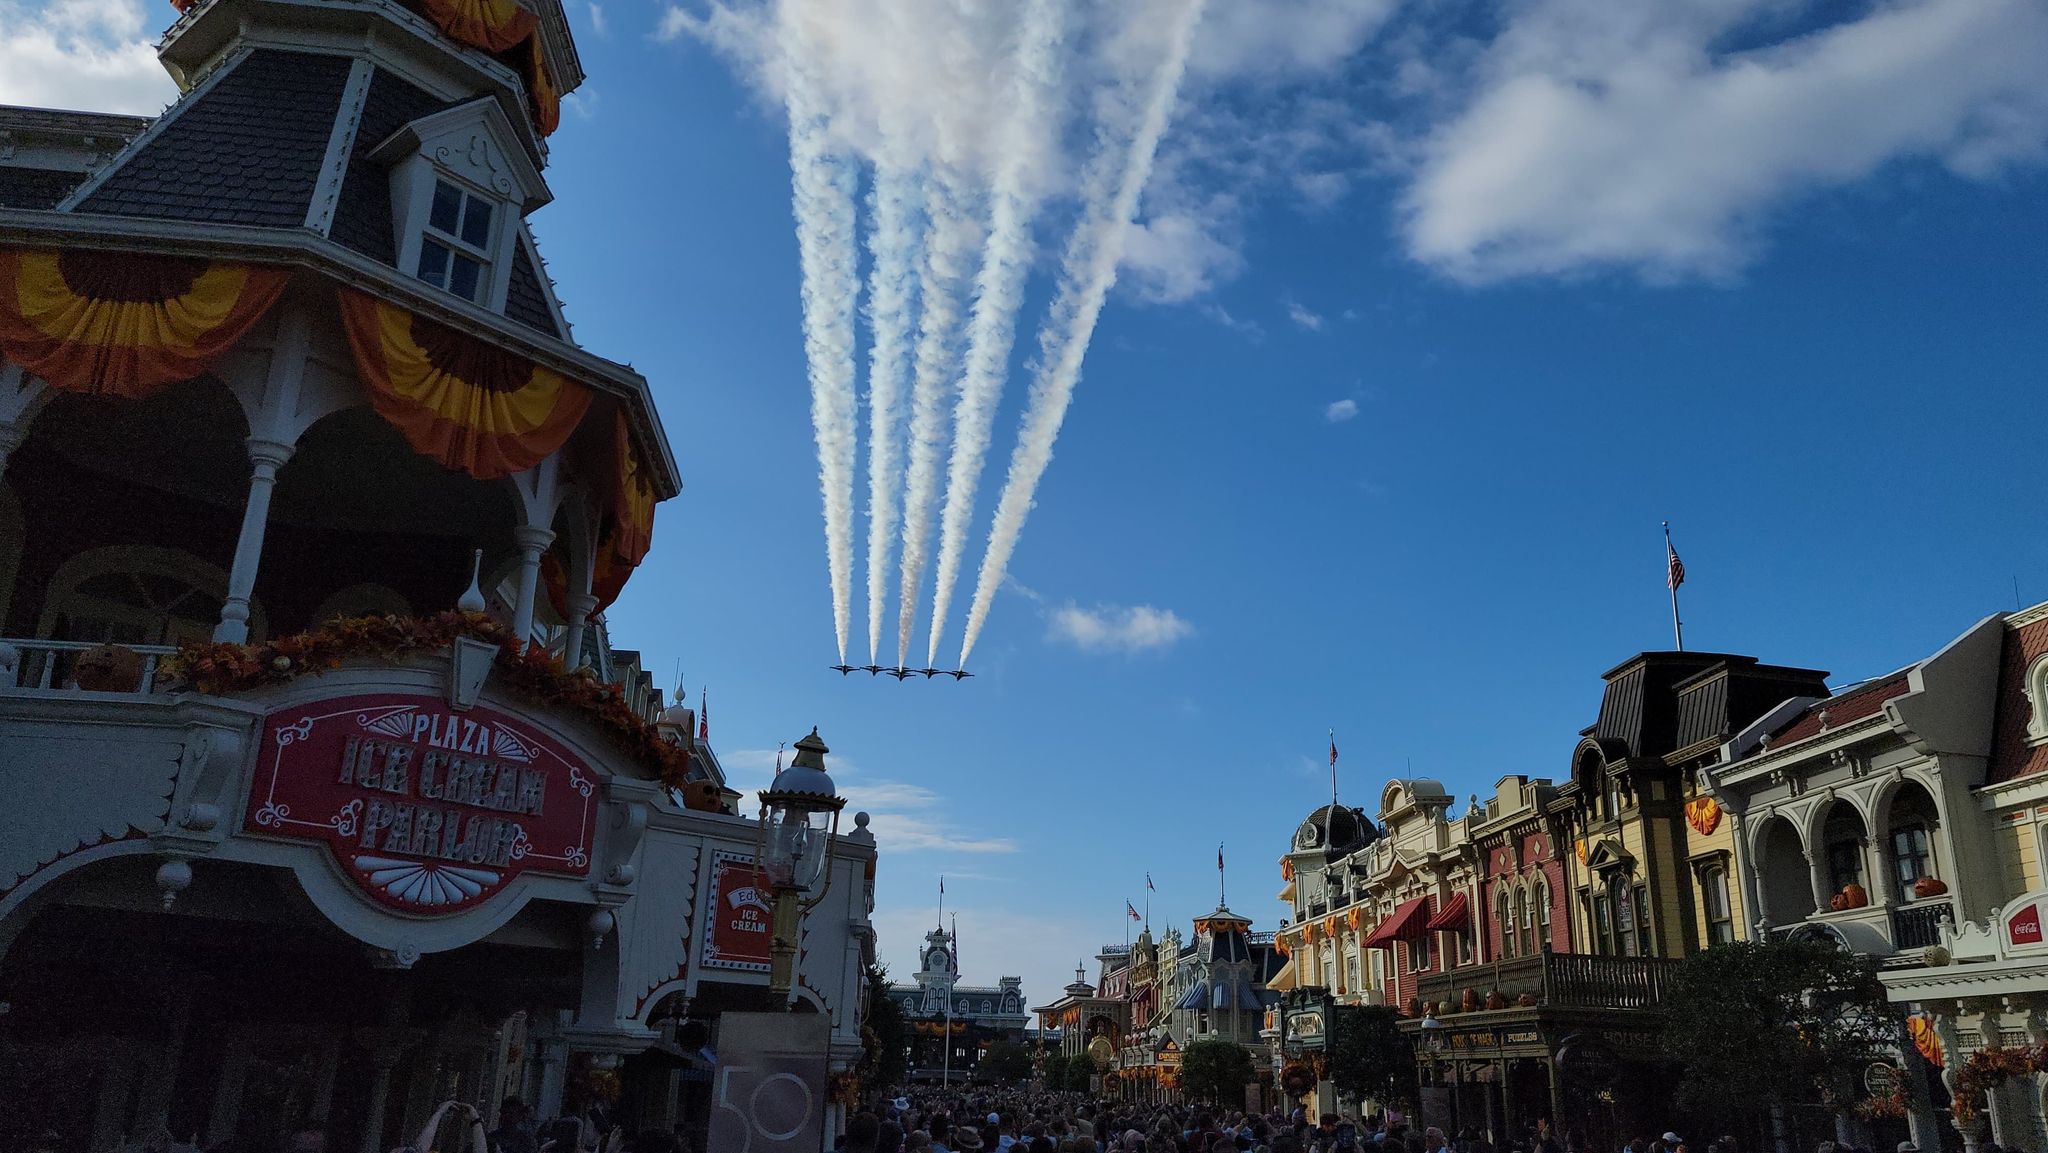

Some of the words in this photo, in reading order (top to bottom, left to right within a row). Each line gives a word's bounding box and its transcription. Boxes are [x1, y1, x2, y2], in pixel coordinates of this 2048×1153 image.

[411, 713, 490, 756] PLAZA
[338, 735, 416, 795] ICE
[420, 749, 549, 817] CREAM
[359, 797, 516, 868] PARLOR
[731, 920, 766, 933] CREAM
[742, 910, 758, 920] ICE
